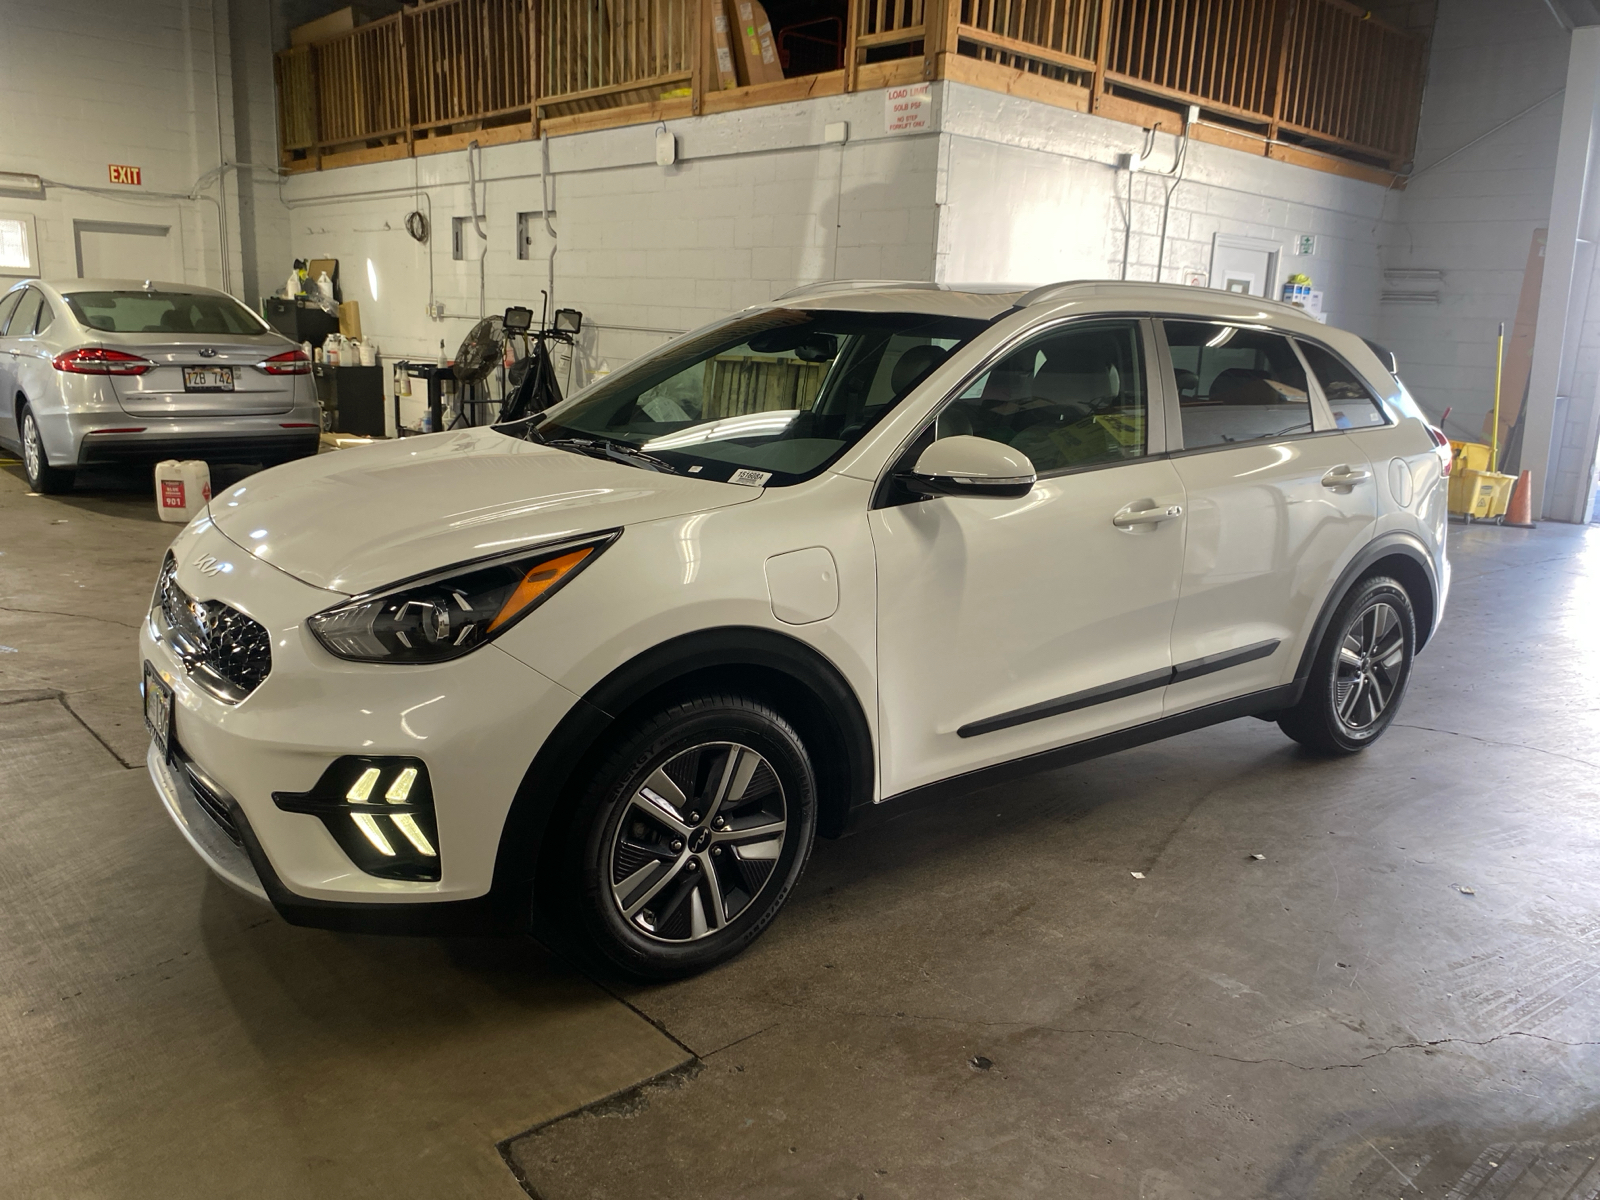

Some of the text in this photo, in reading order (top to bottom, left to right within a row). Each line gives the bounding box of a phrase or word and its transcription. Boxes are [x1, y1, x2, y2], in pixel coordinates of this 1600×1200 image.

[888, 86, 929, 100] LOAD LIMIT
[110, 165, 139, 184] EXIT
[212, 372, 231, 384] 742
[166, 498, 181, 506] 901
